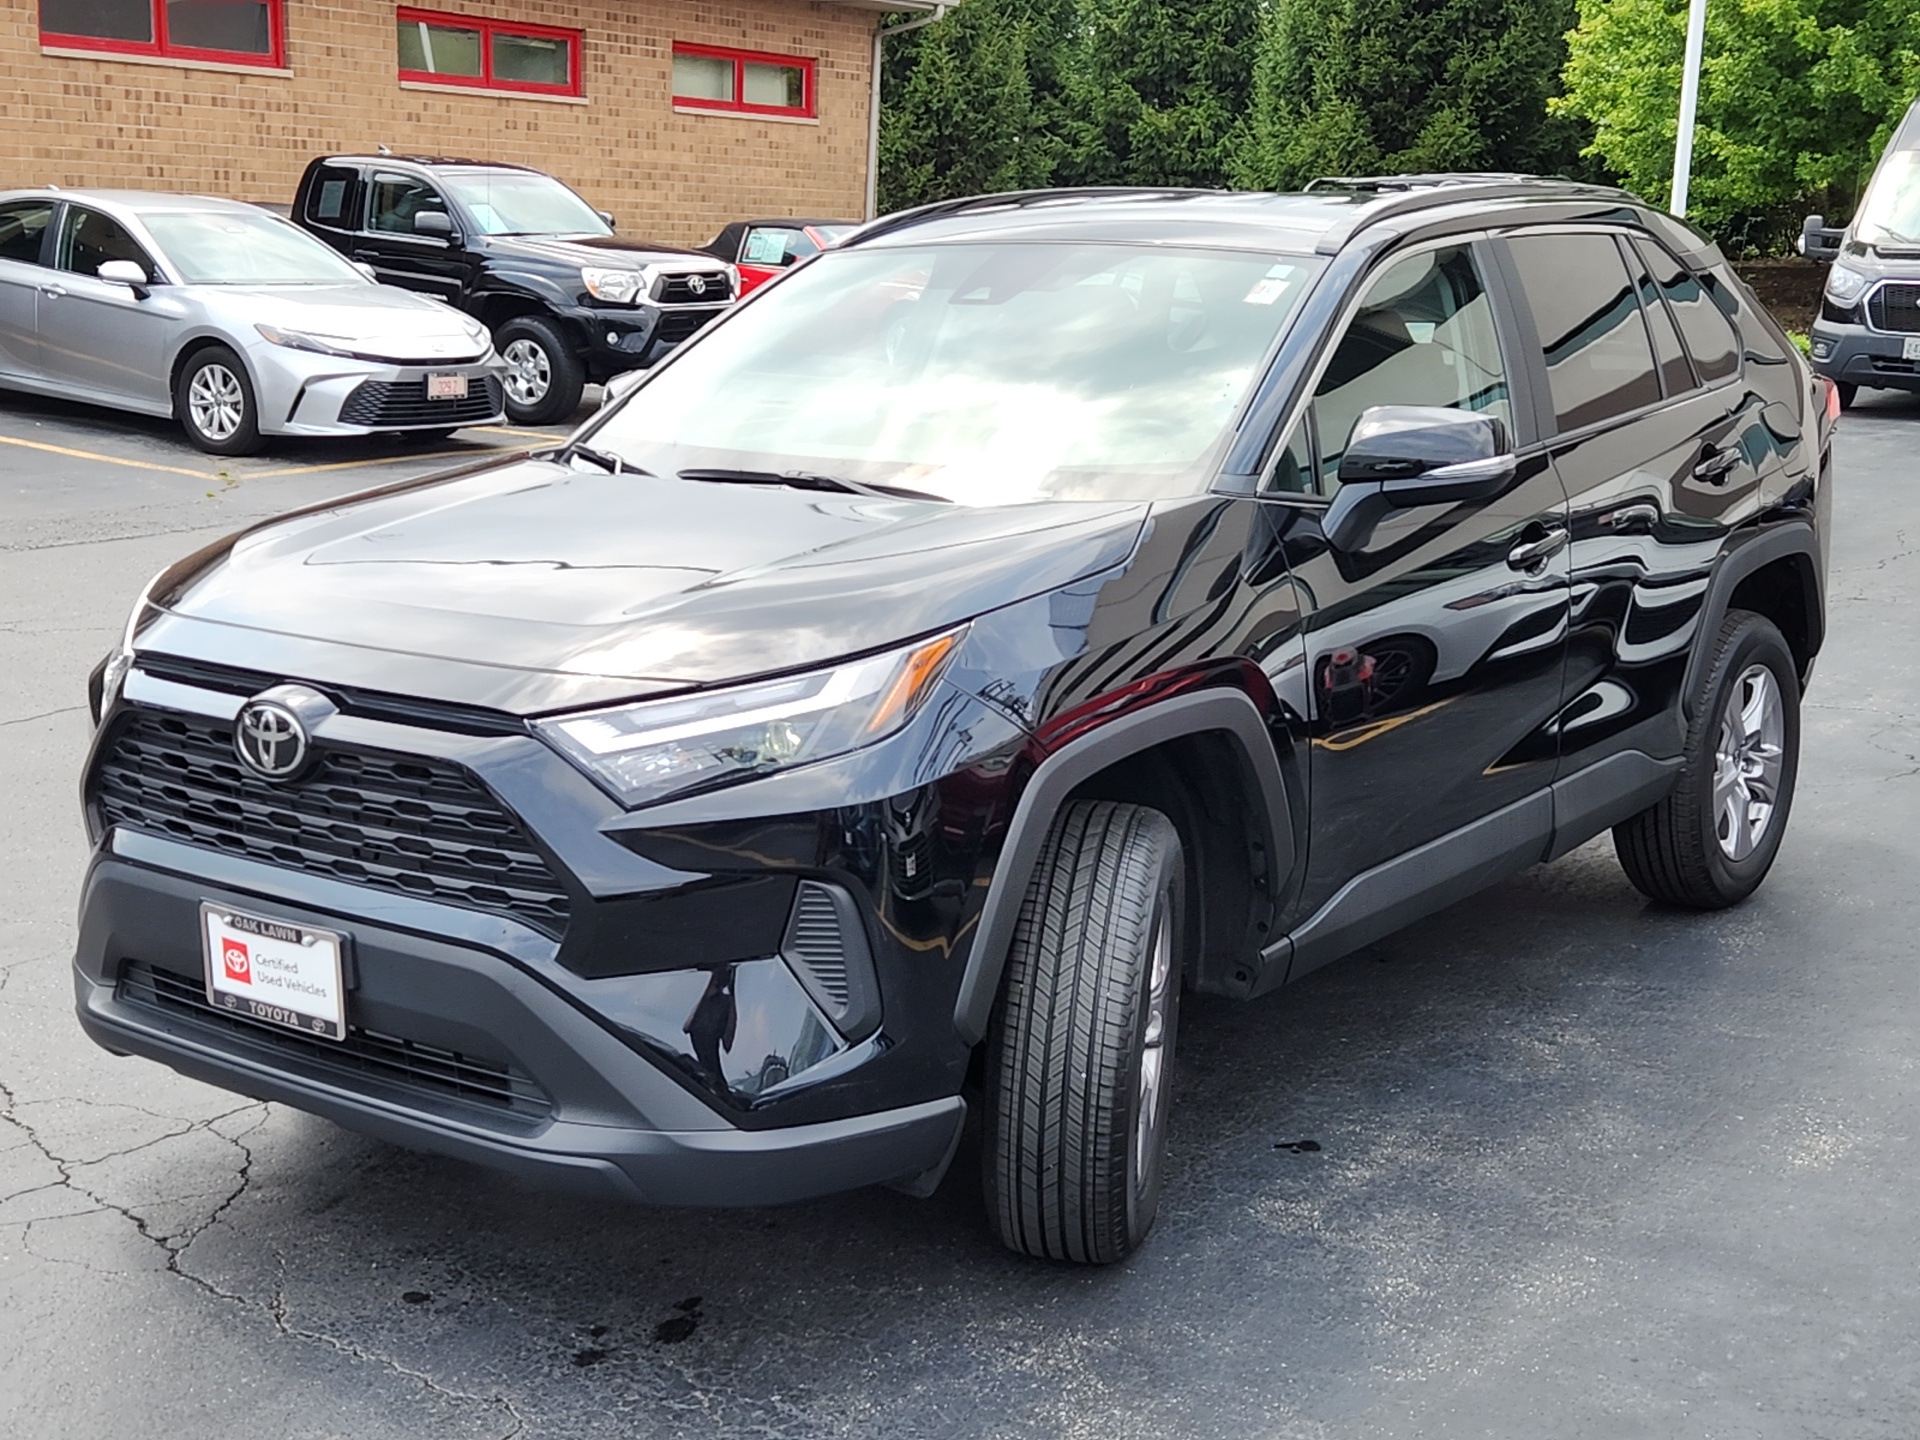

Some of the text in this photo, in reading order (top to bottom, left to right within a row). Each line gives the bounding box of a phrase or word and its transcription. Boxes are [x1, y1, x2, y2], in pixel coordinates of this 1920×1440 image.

[234, 916, 297, 942] OAK LAWN
[255, 953, 299, 974] Certified
[257, 971, 327, 998] Used Vehicles
[249, 1001, 299, 1026] TOYOTA
